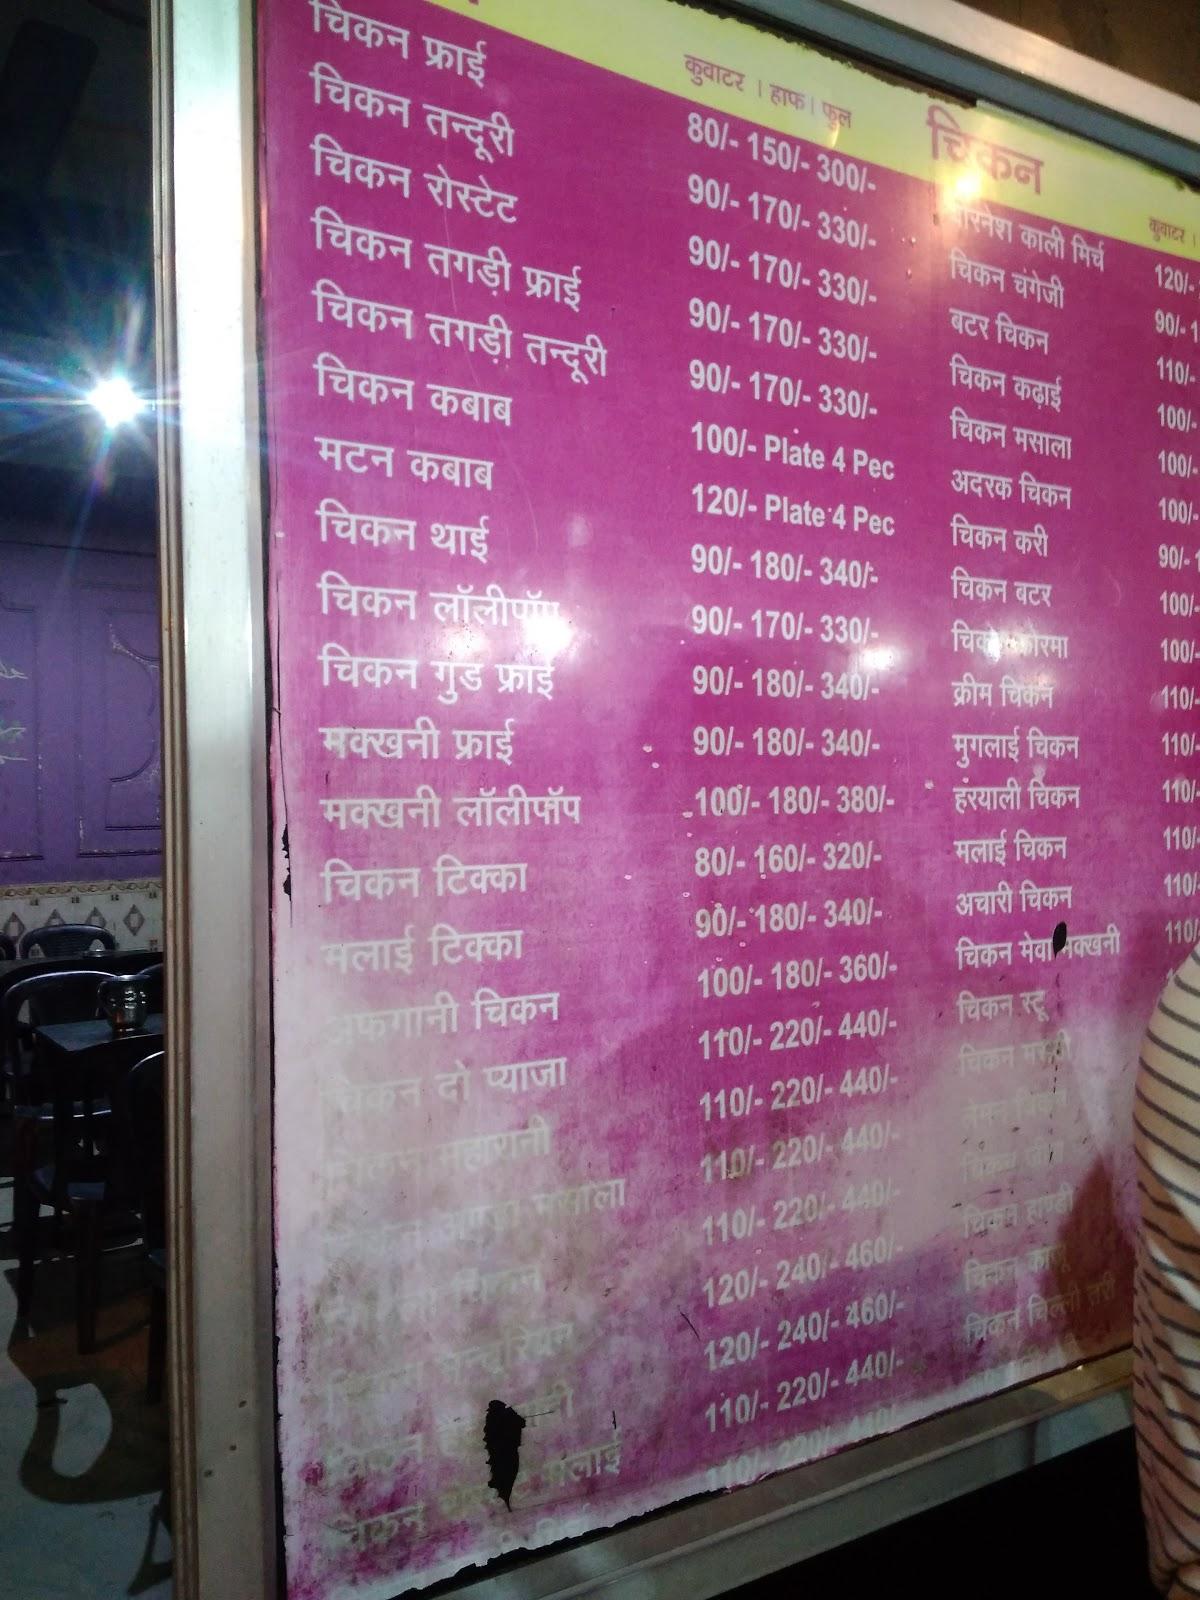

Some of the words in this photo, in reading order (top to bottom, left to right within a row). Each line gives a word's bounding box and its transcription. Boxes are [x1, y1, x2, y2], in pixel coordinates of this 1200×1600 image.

[309, 0, 410, 59] चिकन
[422, 36, 487, 88] फ्राई
[309, 62, 411, 128] चिकन
[422, 103, 515, 163] तन्दूरी
[769, 83, 806, 110] हाफ
[688, 112, 738, 150] 80/-
[748, 132, 809, 173] 150/-
[817, 154, 876, 193] 300/-
[310, 134, 411, 198] चिकन
[424, 164, 518, 223] रोस्टेट
[688, 174, 739, 211] 90/-
[748, 192, 810, 232] 170/-
[817, 212, 876, 250] 330/-
[310, 206, 412, 269] चिकन
[424, 243, 511, 296] तगड़ी
[523, 266, 582, 313] फ्राई
[688, 235, 740, 272] 90/-
[749, 251, 811, 290] 170/-
[818, 269, 877, 306] 330/-
[1018, 224, 1064, 260] काली
[1071, 233, 1105, 272] मिर्च
[950, 247, 1005, 293] चिकन
[1012, 267, 1064, 309] चंगेजी
[1155, 263, 1195, 295] 120/-
[311, 278, 413, 340] चिकन
[425, 314, 512, 364] तगड़ी
[523, 334, 608, 385] तन्दूरी
[689, 297, 740, 333] 90/-
[749, 311, 811, 349] 170/-
[818, 327, 877, 363] 330/-
[949, 308, 990, 340] बटर
[995, 312, 1049, 355] चिकन
[1155, 308, 1186, 337] 90/-
[312, 352, 415, 410] चिकन
[426, 384, 513, 426] कबाब
[689, 359, 741, 394] 90/-
[749, 371, 811, 407] 170/-
[819, 385, 877, 419] 330/-
[950, 353, 1005, 397] चिकन
[1156, 356, 1196, 386] 110/-
[950, 406, 1007, 448] चिकन
[1013, 427, 1072, 460] मसाला
[1157, 403, 1197, 433] 100/-
[314, 437, 394, 477] मटन
[407, 450, 494, 490] कबाब
[691, 421, 756, 457] 100/-
[764, 434, 825, 469] Plate
[832, 447, 846, 472] 4
[853, 449, 895, 480] Pec
[1158, 449, 1198, 479] 100/-
[692, 483, 757, 518] 120/-
[765, 494, 825, 527] Plate
[833, 504, 846, 529] 4
[854, 506, 895, 536] Pec
[951, 469, 1013, 500] अदरक
[1019, 471, 1072, 510] चिकन
[1158, 497, 1199, 525] 100/-
[315, 498, 417, 550] चिकन
[430, 516, 489, 564] थाई
[951, 513, 1007, 552] चिकन
[1013, 523, 1049, 558] करी
[691, 543, 742, 576] 90/-
[751, 550, 812, 582] 180/-
[820, 557, 878, 588] 340/-
[1158, 543, 1190, 570] 90/-
[316, 570, 417, 620] चिकन
[951, 566, 1007, 603] चिकन
[692, 605, 742, 636] 90/-
[751, 609, 813, 640] 170/-
[820, 614, 878, 644] 330/-
[317, 642, 419, 689] चिकन
[692, 665, 743, 695] 90/-
[752, 668, 813, 698] 180/-
[821, 671, 879, 701] 340/-
[951, 672, 993, 707] क्रीम
[999, 675, 1054, 709] चिकन
[319, 716, 440, 760] मक्खनी
[452, 718, 514, 766] फ्राई
[693, 726, 744, 756] 90/-
[753, 727, 814, 756] 180/-
[821, 728, 880, 757] 340/-
[952, 726, 1020, 768] मुगलाई
[1026, 727, 1079, 759] चिकन
[320, 785, 441, 829] मक्खनी
[452, 784, 581, 827] लॉलीपॉप
[695, 786, 760, 816] 100/-
[769, 785, 829, 815] 180/-
[837, 784, 895, 813] 380/-
[1028, 779, 1080, 810] चिकन
[695, 846, 745, 877] 80/-
[754, 843, 815, 873] 160/-
[823, 840, 882, 871] 320/-
[953, 828, 1007, 866] मलाई
[1013, 828, 1067, 861] चिकन
[320, 858, 420, 903] चिकन
[433, 854, 528, 897] टिक्का
[955, 880, 1013, 917] अचारी
[1019, 880, 1072, 912] चिकन
[695, 906, 746, 938] 90/-
[754, 901, 816, 933] 180/-
[824, 897, 883, 928] 340/-
[428, 923, 524, 967] टिक्का
[955, 936, 1012, 970] चिकन
[1018, 931, 1053, 964] मेवा
[697, 964, 762, 998] 100/-
[771, 957, 832, 990] 180/-
[839, 951, 897, 983] 360/-
[472, 987, 560, 1030] चिकन
[956, 989, 1013, 1025] चिकन
[698, 1024, 762, 1060] 110/-
[770, 1015, 832, 1050] 220/-
[838, 1007, 897, 1039] 440/-
[483, 1057, 567, 1094] प्याजा
[699, 1085, 763, 1121] 110/-
[771, 1073, 833, 1110] 220/-
[840, 1063, 898, 1097] 440/-
[701, 1145, 764, 1184] 110/-
[772, 1132, 834, 1170] 220/-
[702, 1205, 765, 1245] 110/-
[773, 1192, 835, 1230] 220/-
[703, 1266, 768, 1308] 120/-
[704, 1327, 769, 1371] 120/-
[778, 1308, 839, 1352] 240/-
[845, 1290, 905, 1328] 460/-
[705, 1390, 769, 1433] 110/-
[777, 1368, 839, 1413] 220/-
[845, 1349, 904, 1386] 440/-
